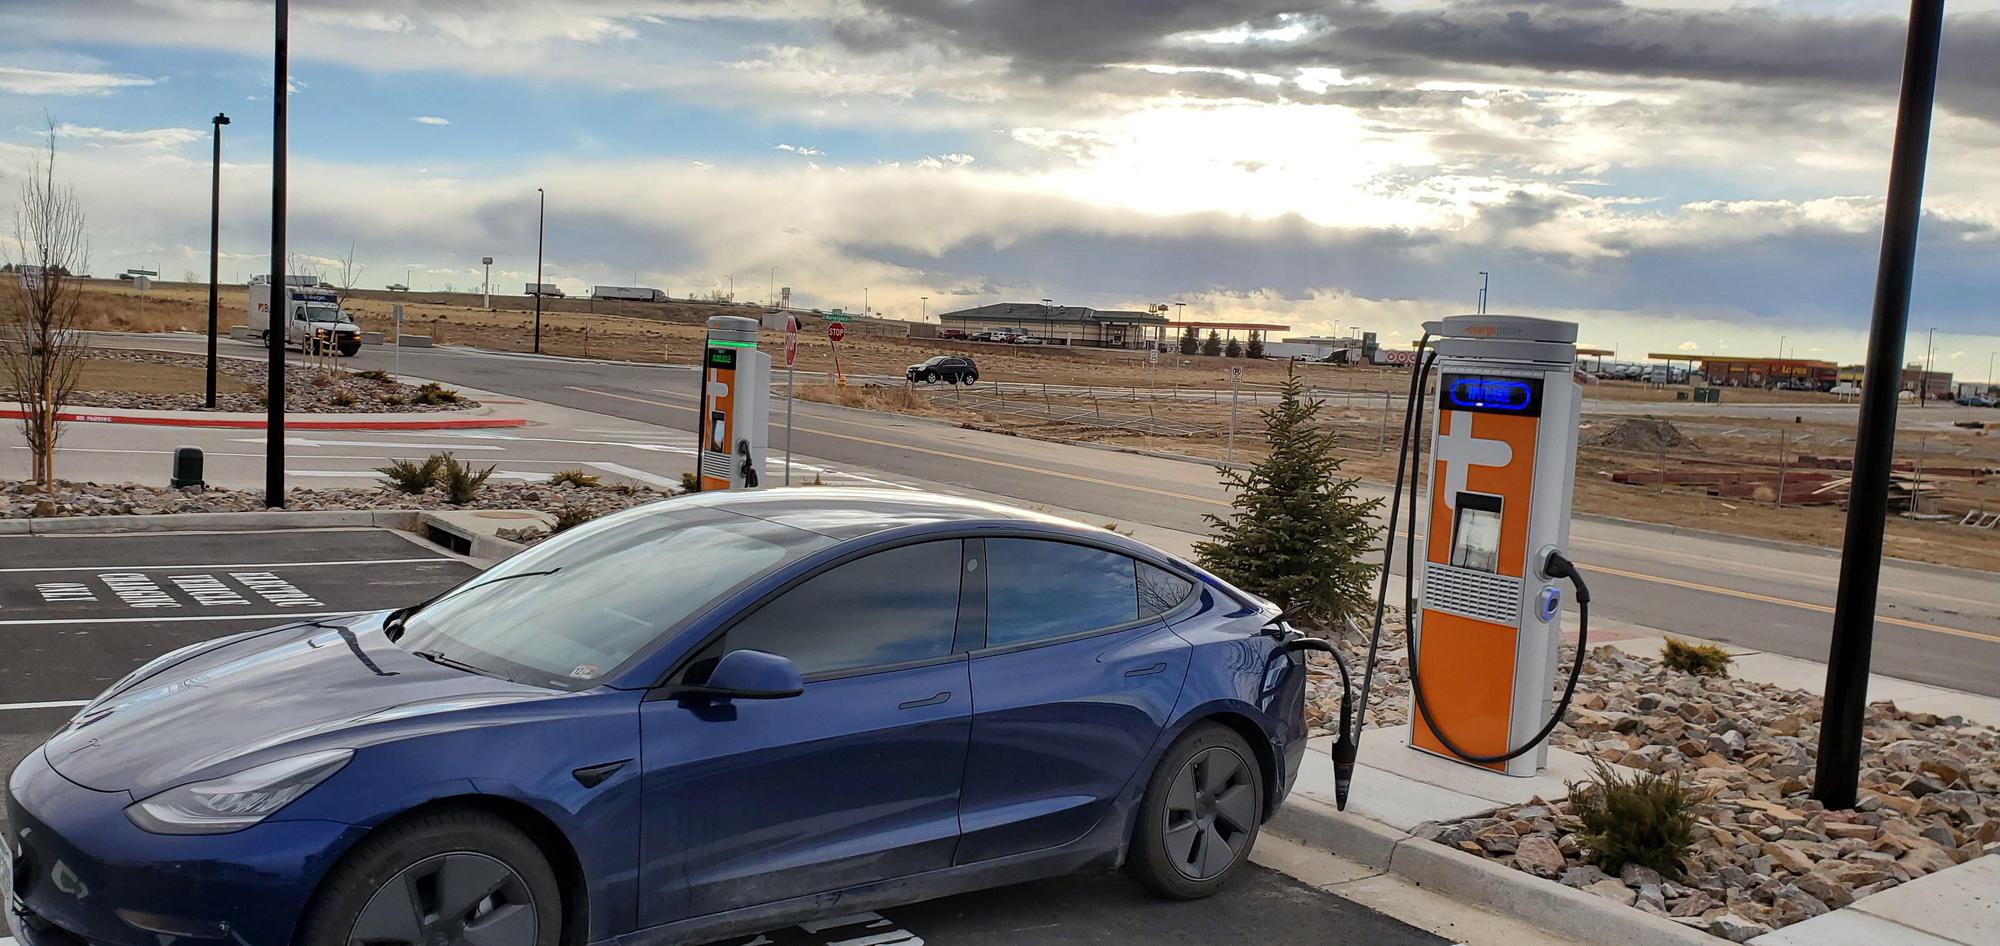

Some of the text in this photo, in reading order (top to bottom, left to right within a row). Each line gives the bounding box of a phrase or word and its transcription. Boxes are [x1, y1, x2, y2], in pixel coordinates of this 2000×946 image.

[829, 328, 844, 336] STOP
[1468, 385, 1511, 403] IN USE
[35, 582, 99, 602] ONLY
[97, 572, 183, 608] CHARGING
[228, 572, 327, 608] ELECTRIC
